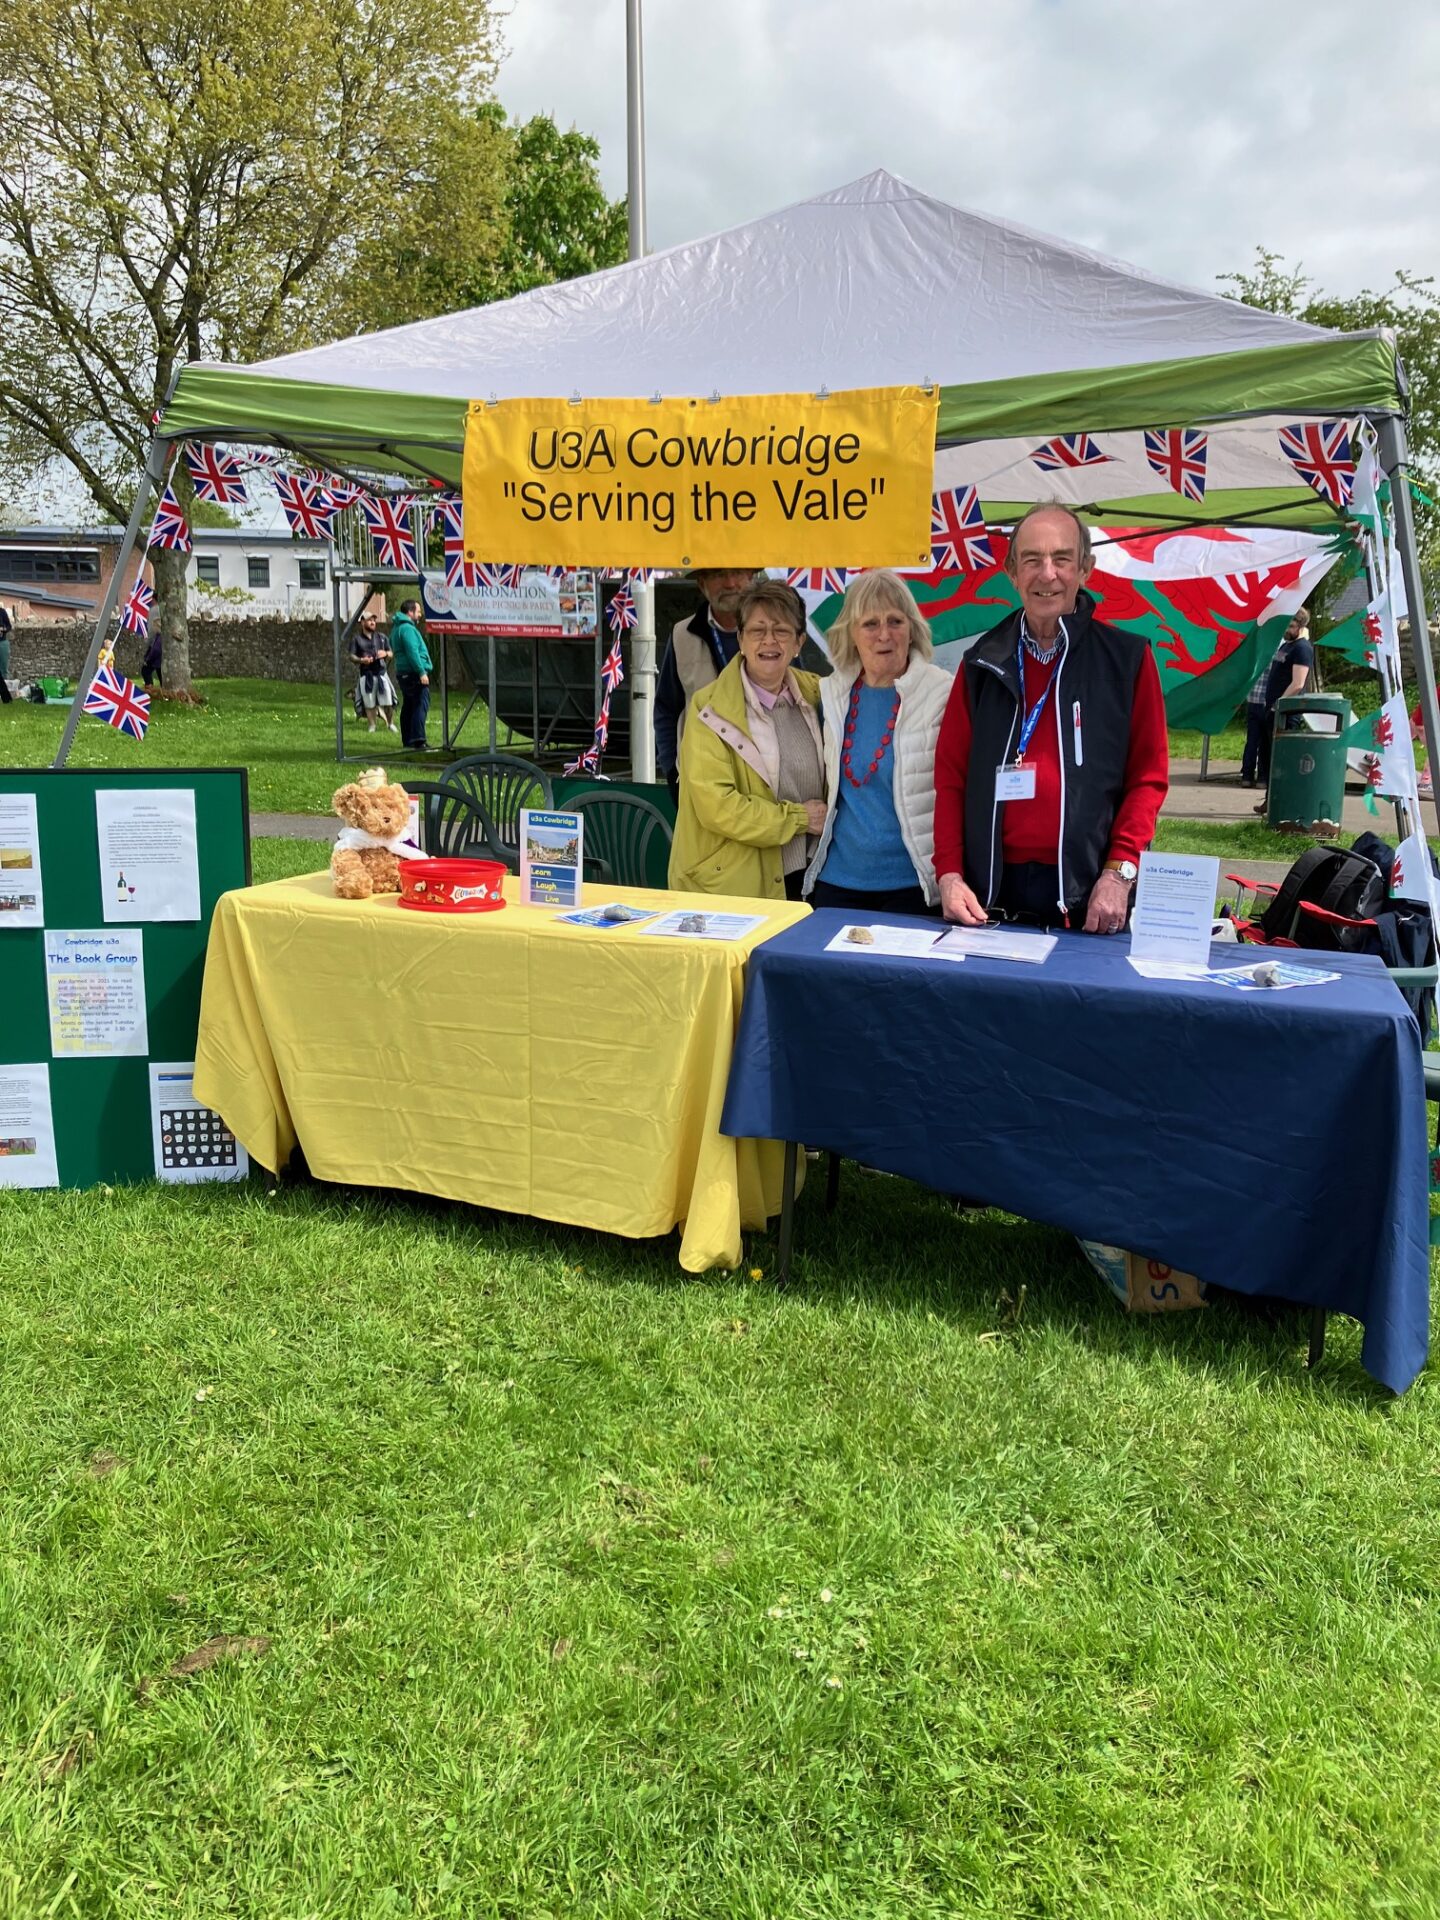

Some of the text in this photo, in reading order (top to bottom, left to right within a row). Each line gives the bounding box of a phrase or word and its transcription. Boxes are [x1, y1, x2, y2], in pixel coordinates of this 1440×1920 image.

[530, 427, 860, 475] U3A Cowbridge
[504, 478, 886, 532] "Serving the Vale"
[464, 586, 547, 598] CORONATION
[543, 816, 576, 826] Cowbridge
[531, 867, 552, 876] Learn
[1159, 867, 1194, 877] Cowbridge
[535, 881, 557, 891] Laugh
[545, 895, 560, 903] Live
[64, 938, 103, 946] Cowbridge
[48, 953, 138, 966] The Book Group
